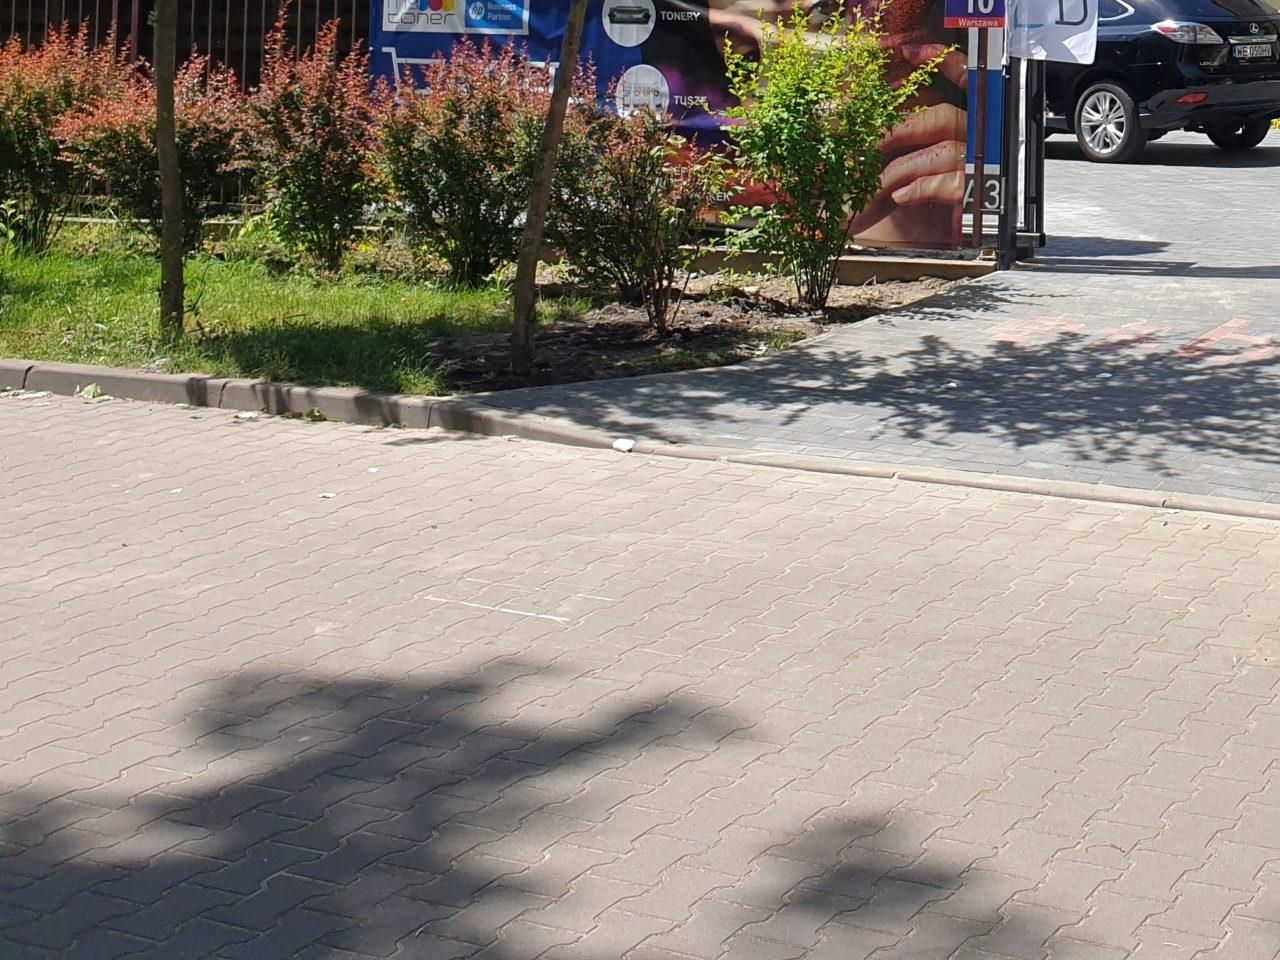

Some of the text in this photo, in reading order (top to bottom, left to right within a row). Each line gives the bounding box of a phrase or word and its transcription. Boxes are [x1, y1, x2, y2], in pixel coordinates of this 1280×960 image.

[487, 2, 517, 11] Business
[387, 11, 456, 25] toner
[487, 13, 512, 22] Partner
[660, 10, 701, 22] TONERY
[958, 18, 999, 27] Warszawa
